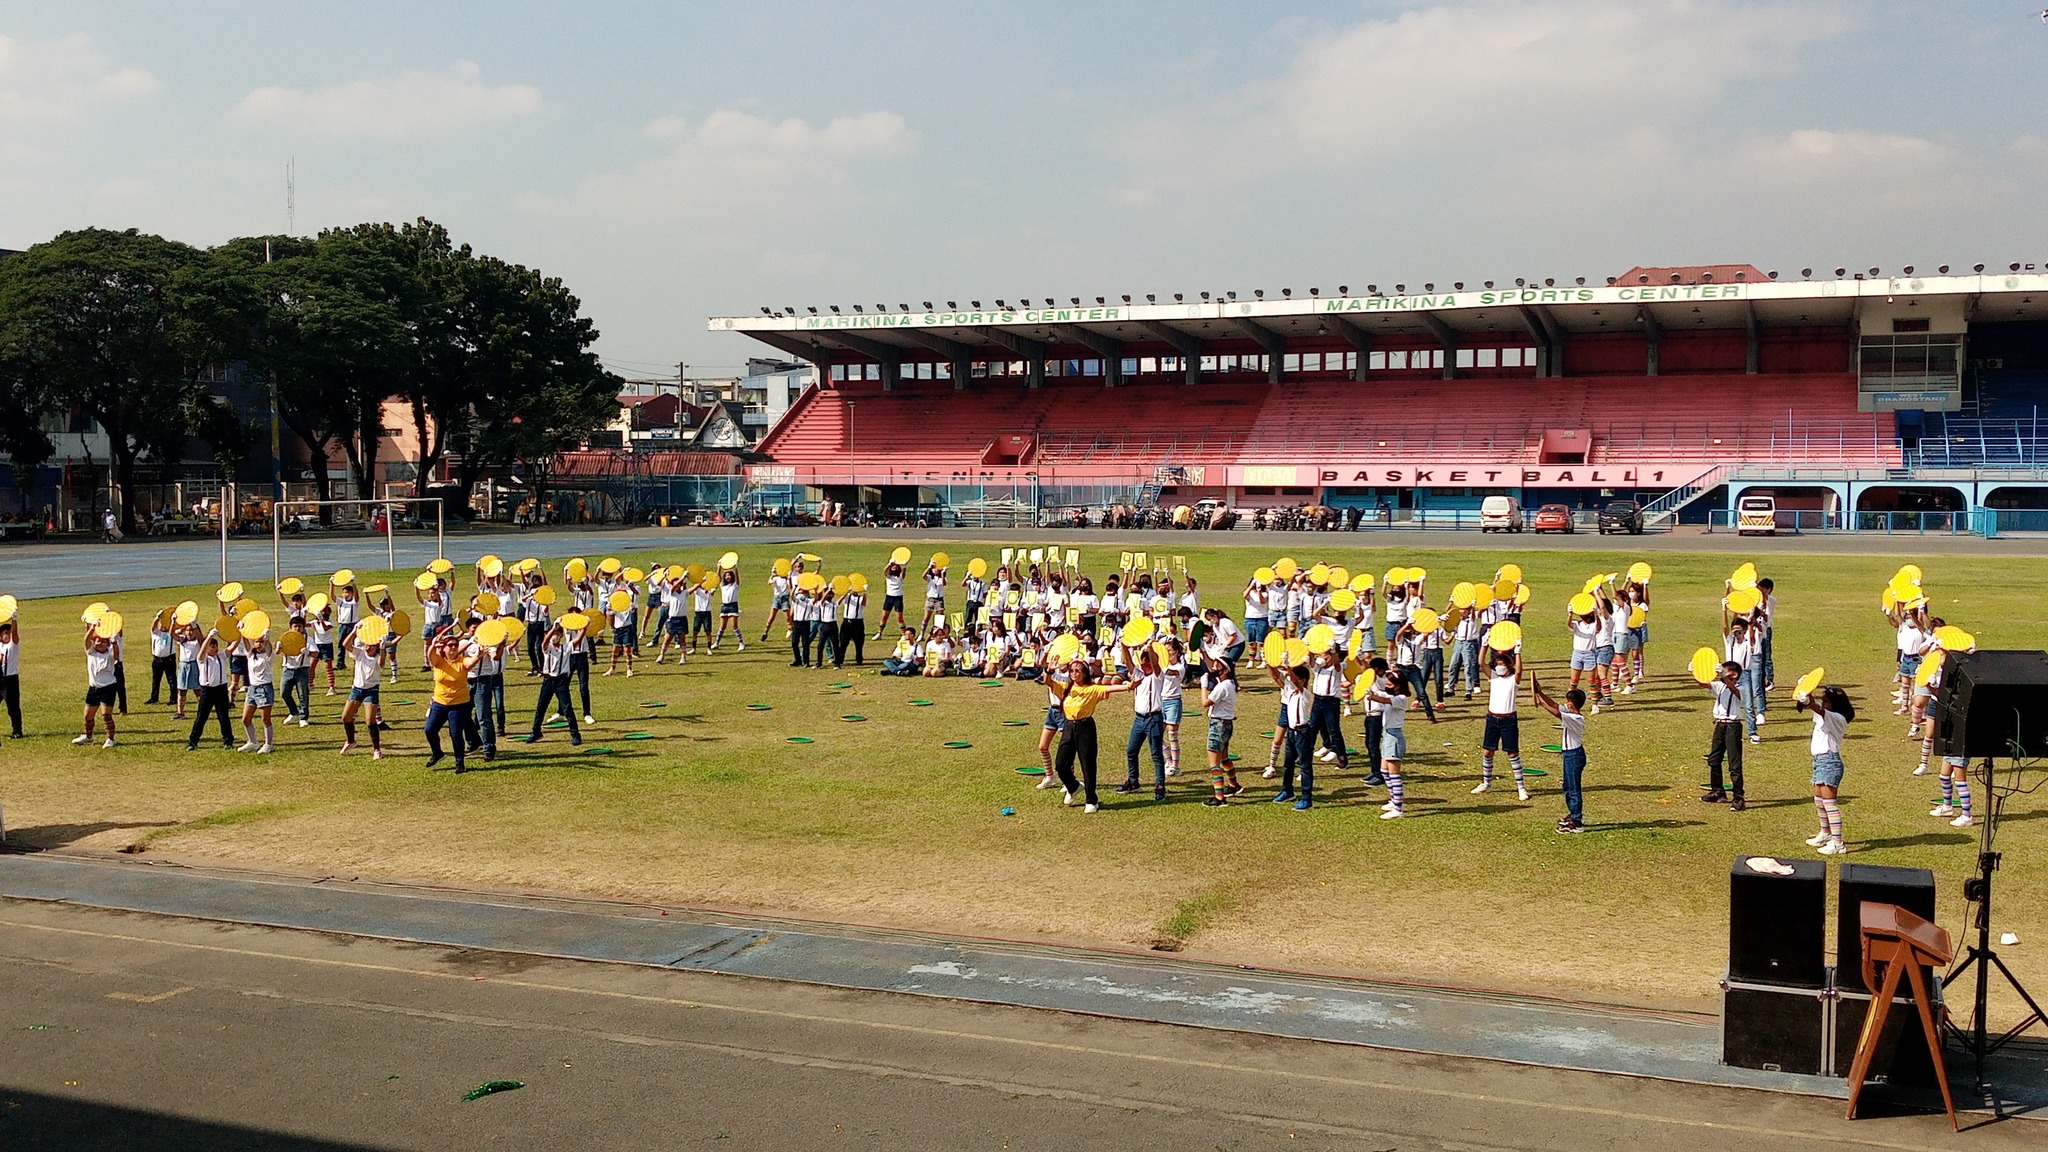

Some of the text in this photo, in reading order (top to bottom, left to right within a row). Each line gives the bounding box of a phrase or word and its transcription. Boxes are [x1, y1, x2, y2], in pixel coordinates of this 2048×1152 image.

[1326, 285, 1740, 311] MARIKINA SPORTS CENTER
[806, 308, 1120, 328] MARIKINA SPORTS CENTER
[900, 471, 1037, 481] TENNIS
